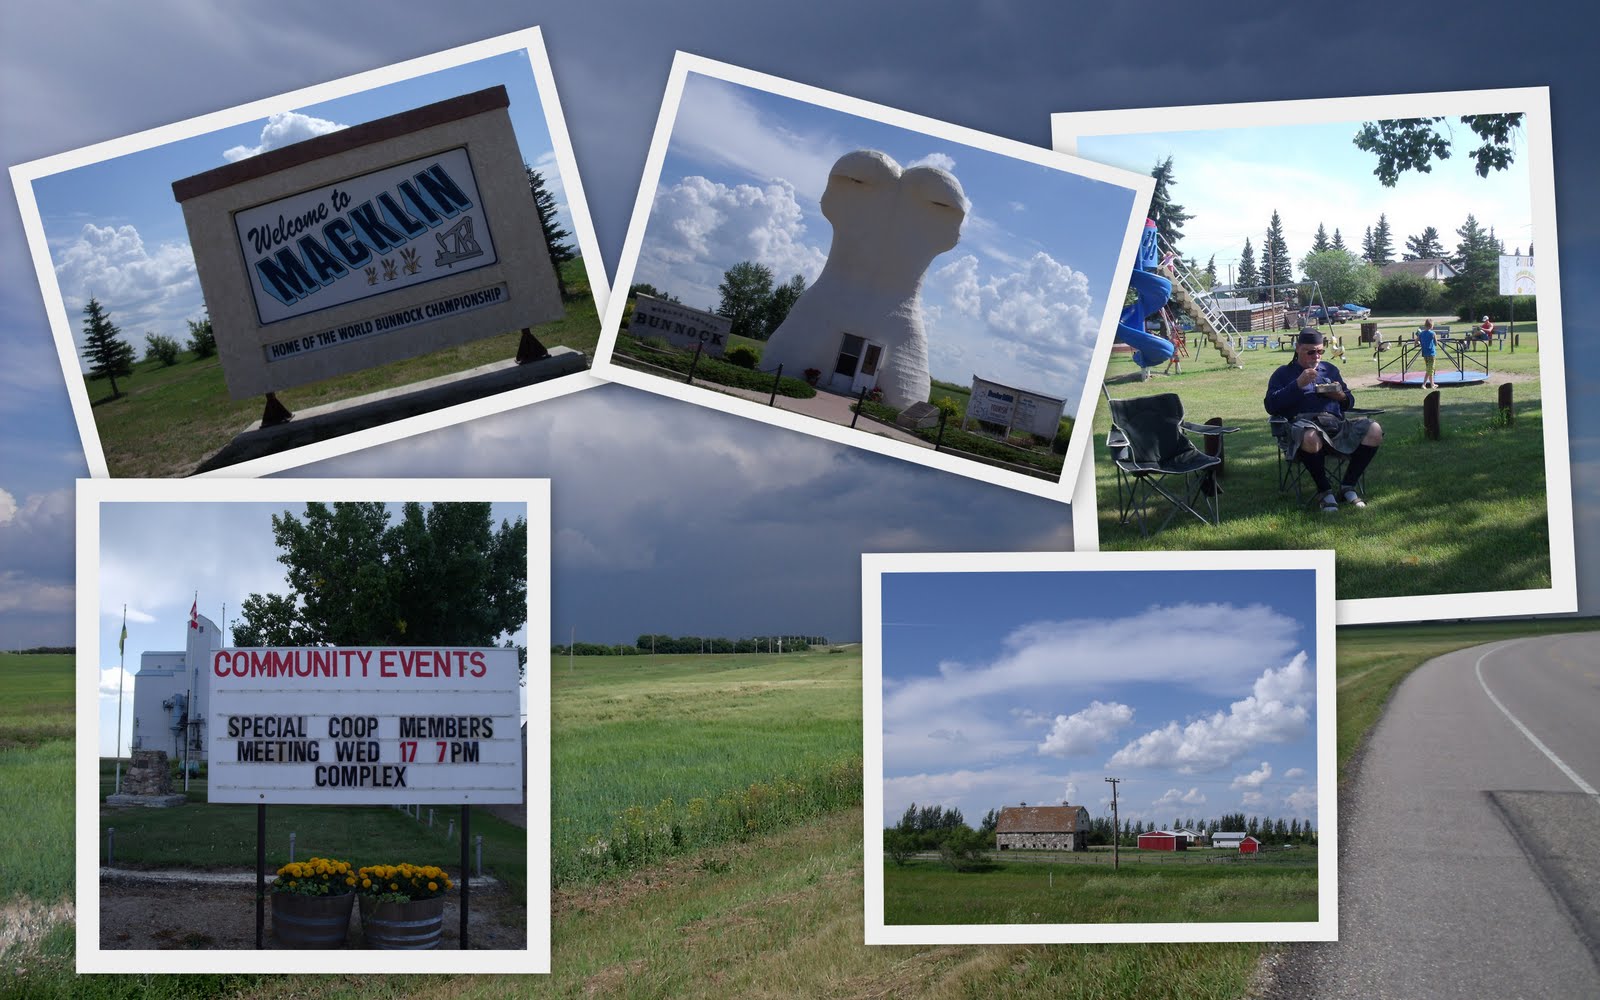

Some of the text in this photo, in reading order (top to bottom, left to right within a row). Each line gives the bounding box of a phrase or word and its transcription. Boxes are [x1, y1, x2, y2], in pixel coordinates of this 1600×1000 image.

[248, 189, 351, 254] Welcome to
[255, 163, 472, 305] MACKLIN
[272, 287, 501, 358] HOME OF THE WORLD BUNNOCK CHAMPIONSHIP
[636, 312, 725, 346] BUNNOCK
[214, 651, 487, 678] COMMUNITY EVENTS
[228, 716, 494, 739] SPECIAL COOP MEMBERS
[237, 741, 319, 763] MEETING
[335, 741, 380, 763] WED
[400, 741, 418, 763] 17
[315, 766, 407, 788] COMPLEX
